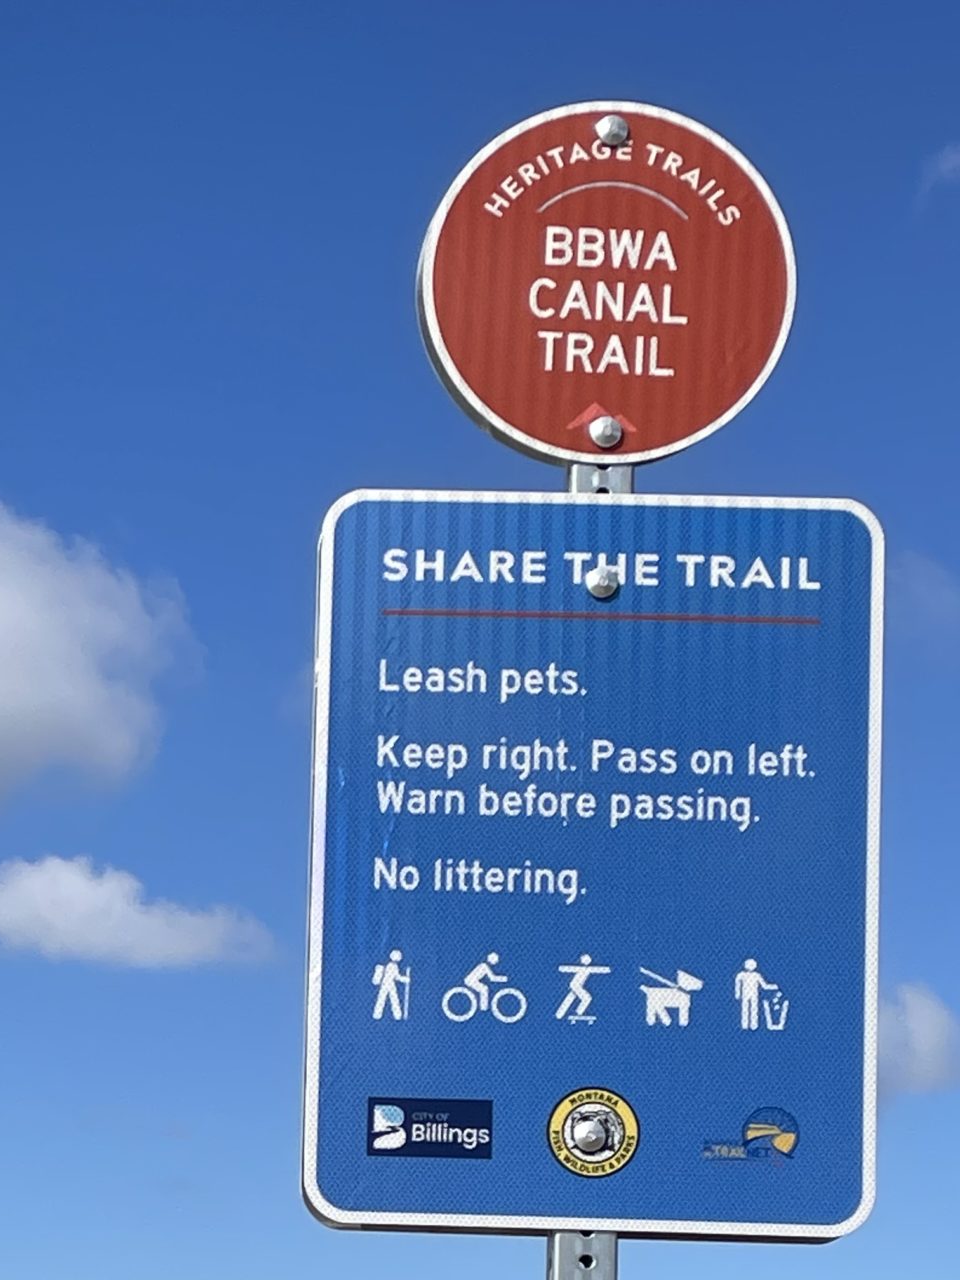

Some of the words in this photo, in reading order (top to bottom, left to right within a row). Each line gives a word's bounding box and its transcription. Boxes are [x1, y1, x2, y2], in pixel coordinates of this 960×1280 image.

[484, 139, 633, 218] HERITAGE
[645, 143, 741, 227] TRAILS
[544, 226, 678, 272] BBWA
[528, 277, 689, 325] CANAL
[537, 331, 675, 377] TRAIL
[382, 549, 547, 585] SHARE
[564, 552, 660, 587] THE
[677, 554, 821, 590] TRAIL
[378, 659, 487, 693] Leash
[500, 662, 587, 703] pets.
[376, 736, 468, 778] Keep
[482, 739, 577, 780] right.
[591, 740, 677, 774] Pass
[690, 749, 734, 776] on
[748, 744, 816, 778] left.
[377, 782, 465, 815] Warn
[478, 785, 597, 820] before
[610, 789, 761, 832] passing.
[373, 858, 420, 891] No
[434, 860, 587, 905] littering.
[412, 1111, 433, 1121] CITY
[435, 1112, 450, 1121] OF
[568, 1092, 620, 1108] MONTANA
[411, 1122, 490, 1150] Billings
[563, 1154, 608, 1174] WILDLIFE
[614, 1135, 636, 1166] PARKS
